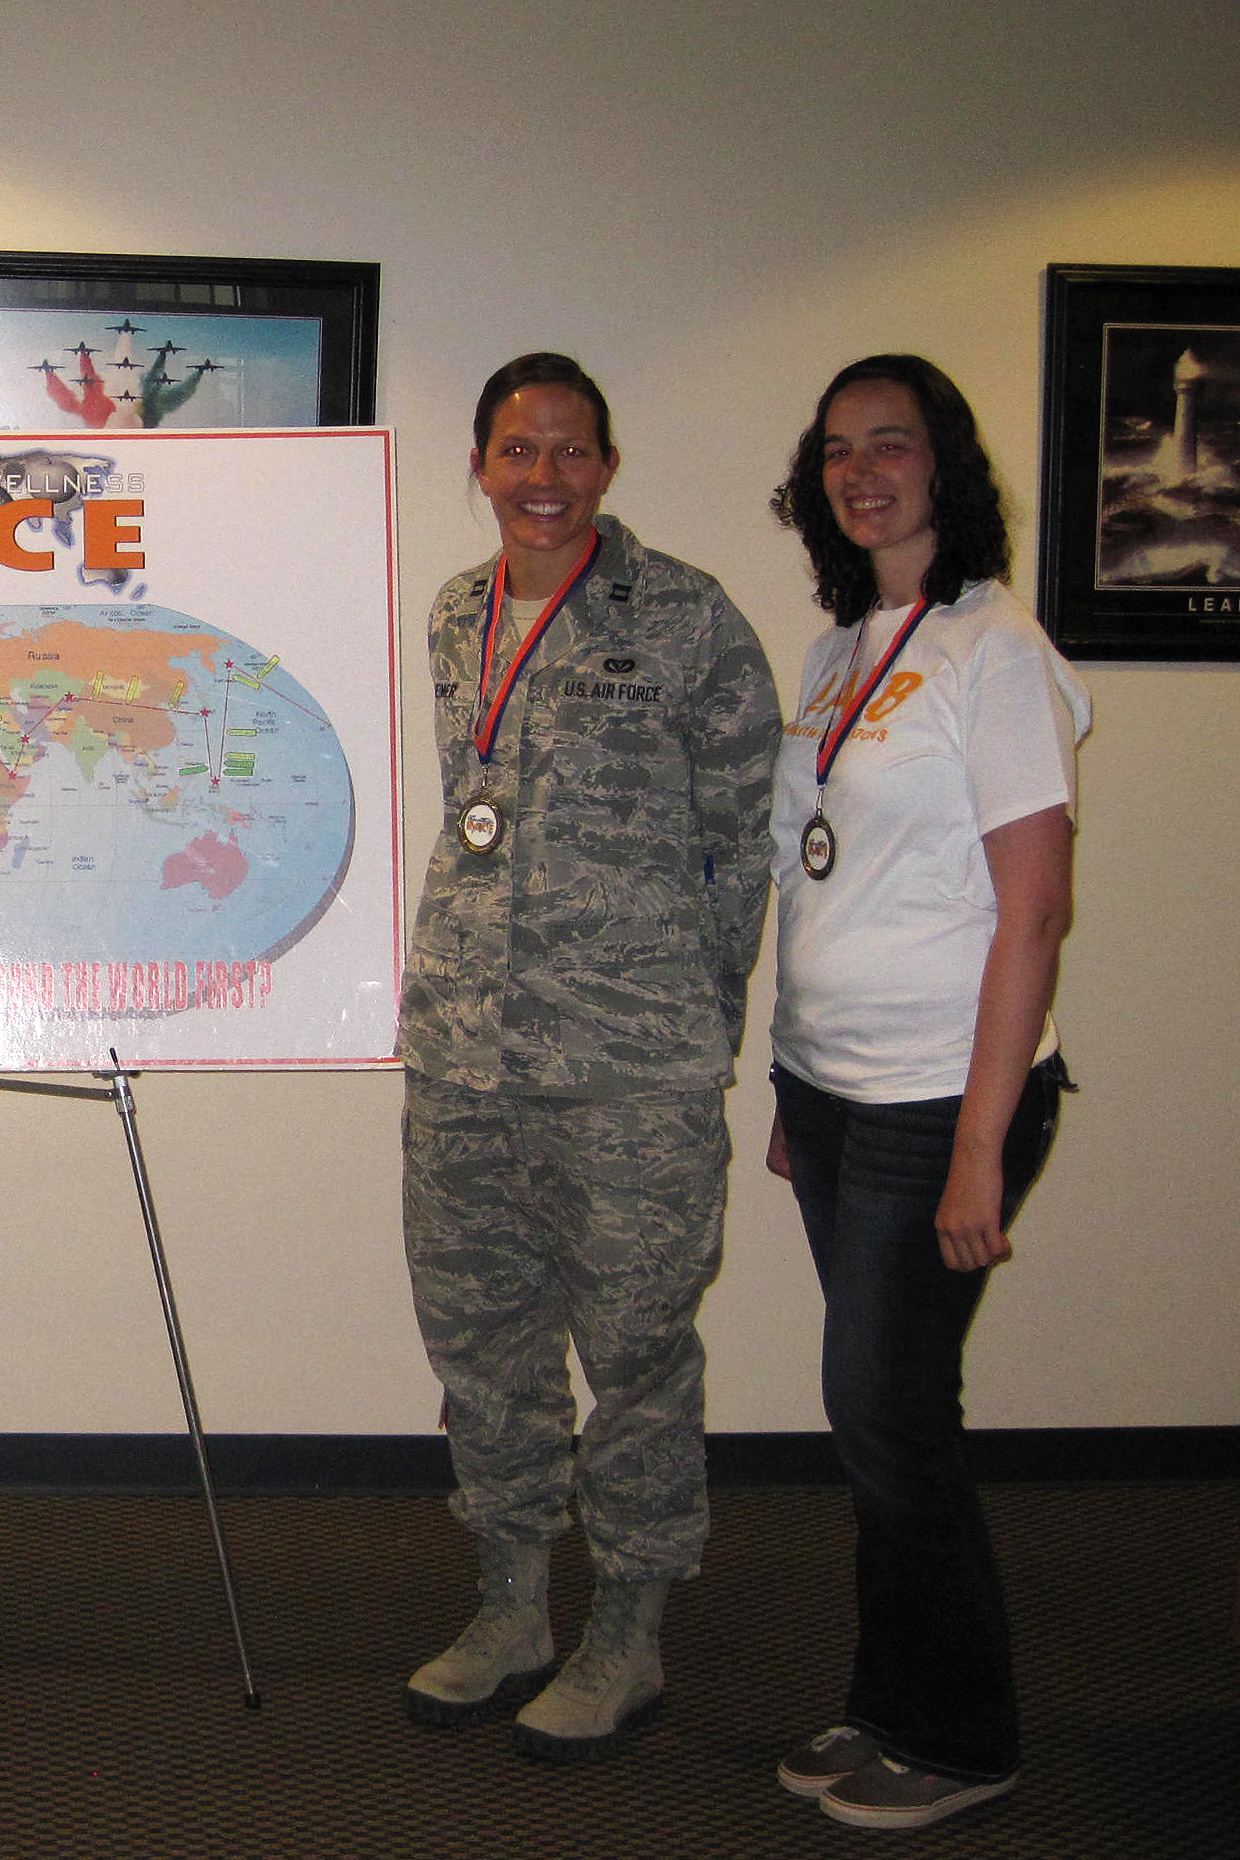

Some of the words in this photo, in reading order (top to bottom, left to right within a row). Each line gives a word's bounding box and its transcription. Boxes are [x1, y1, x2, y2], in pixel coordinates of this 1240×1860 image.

[1188, 597, 1240, 611] LEA
[591, 682, 615, 699] AIR
[619, 683, 664, 702] FORCE
[63, 962, 101, 1010] THE
[107, 961, 188, 1010] WORLD
